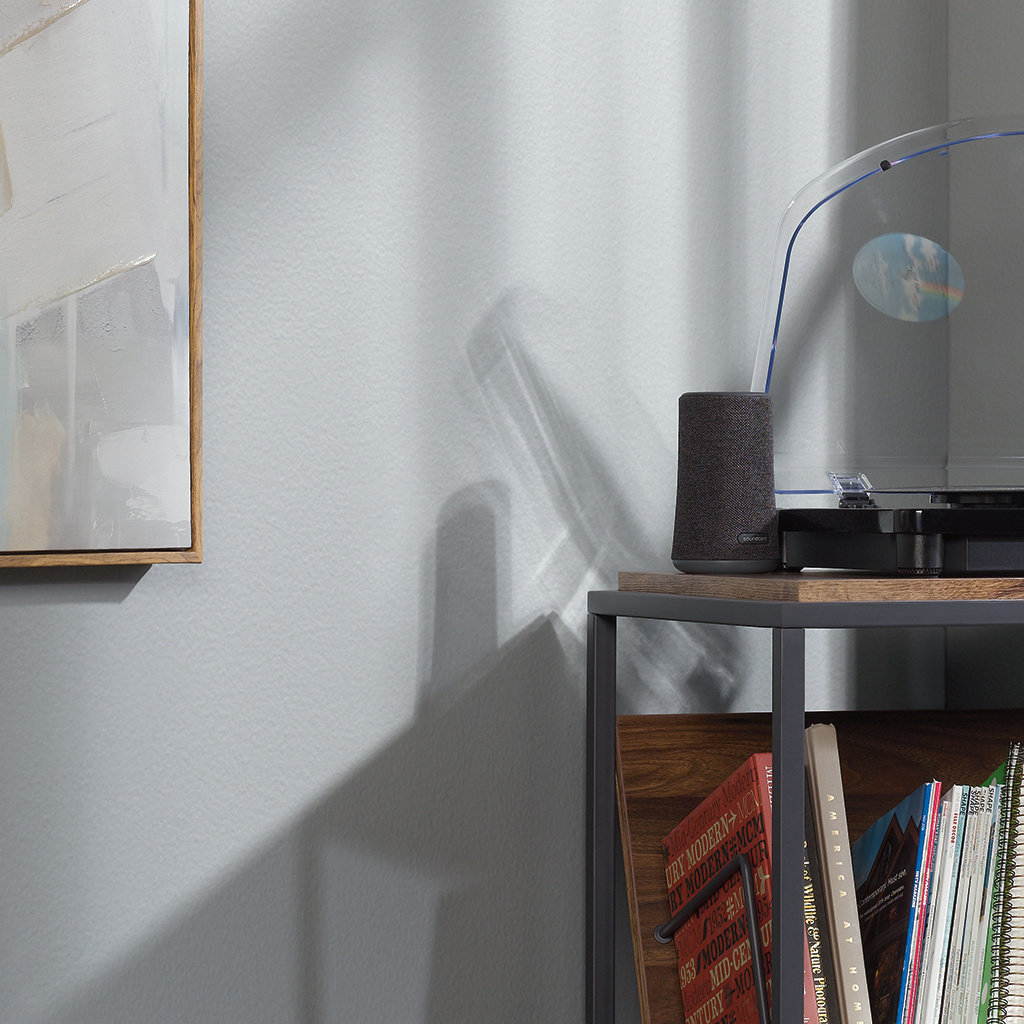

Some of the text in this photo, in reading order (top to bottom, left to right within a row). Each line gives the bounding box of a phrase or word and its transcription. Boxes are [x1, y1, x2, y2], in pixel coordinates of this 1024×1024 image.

[685, 841, 730, 898] MODERN
[686, 812, 730, 870] MODERN
[826, 793, 847, 898] AMERICA
[843, 920, 853, 943] AT
[809, 940, 822, 973] Nature
